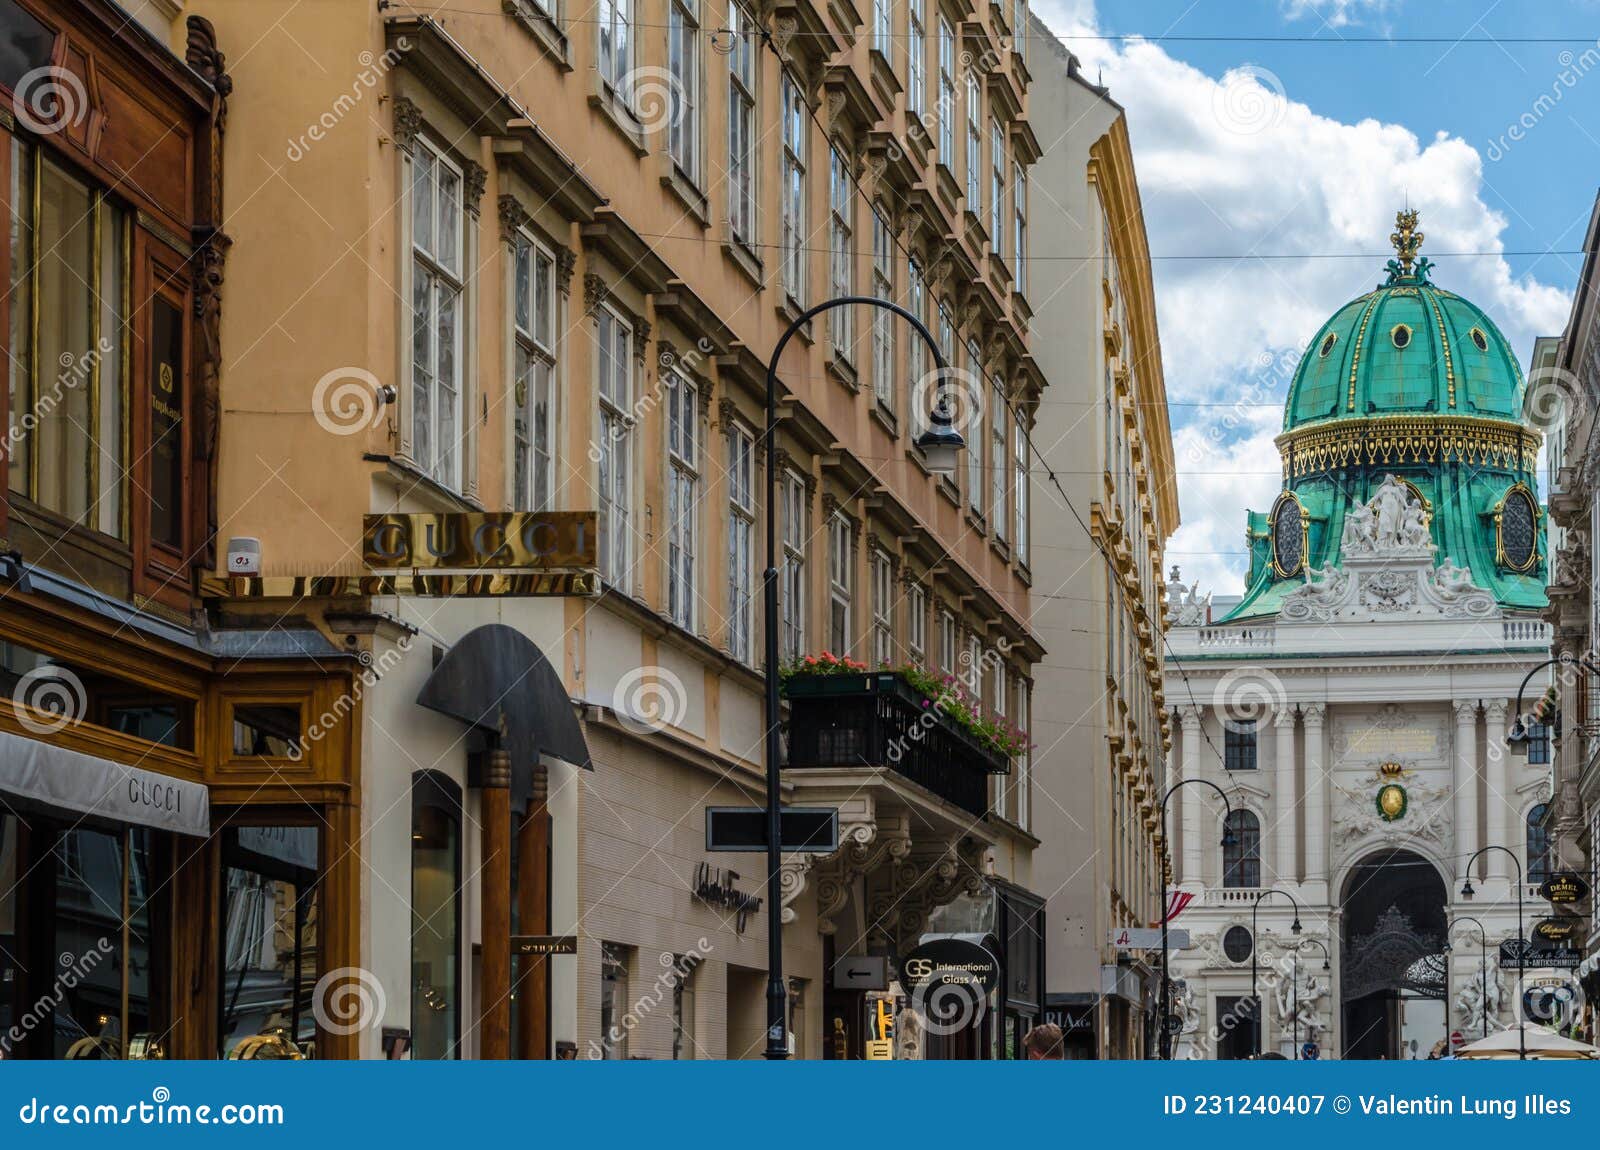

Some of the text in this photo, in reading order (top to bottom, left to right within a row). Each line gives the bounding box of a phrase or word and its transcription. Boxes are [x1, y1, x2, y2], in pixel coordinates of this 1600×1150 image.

[373, 522, 586, 558] GUCCI
[128, 778, 181, 814] GUCCI
[1550, 884, 1578, 892] DEMEL
[936, 962, 993, 971] International
[1501, 959, 1530, 967] JUWELN
[905, 959, 932, 978] GS
[942, 975, 987, 984] Glass Art
